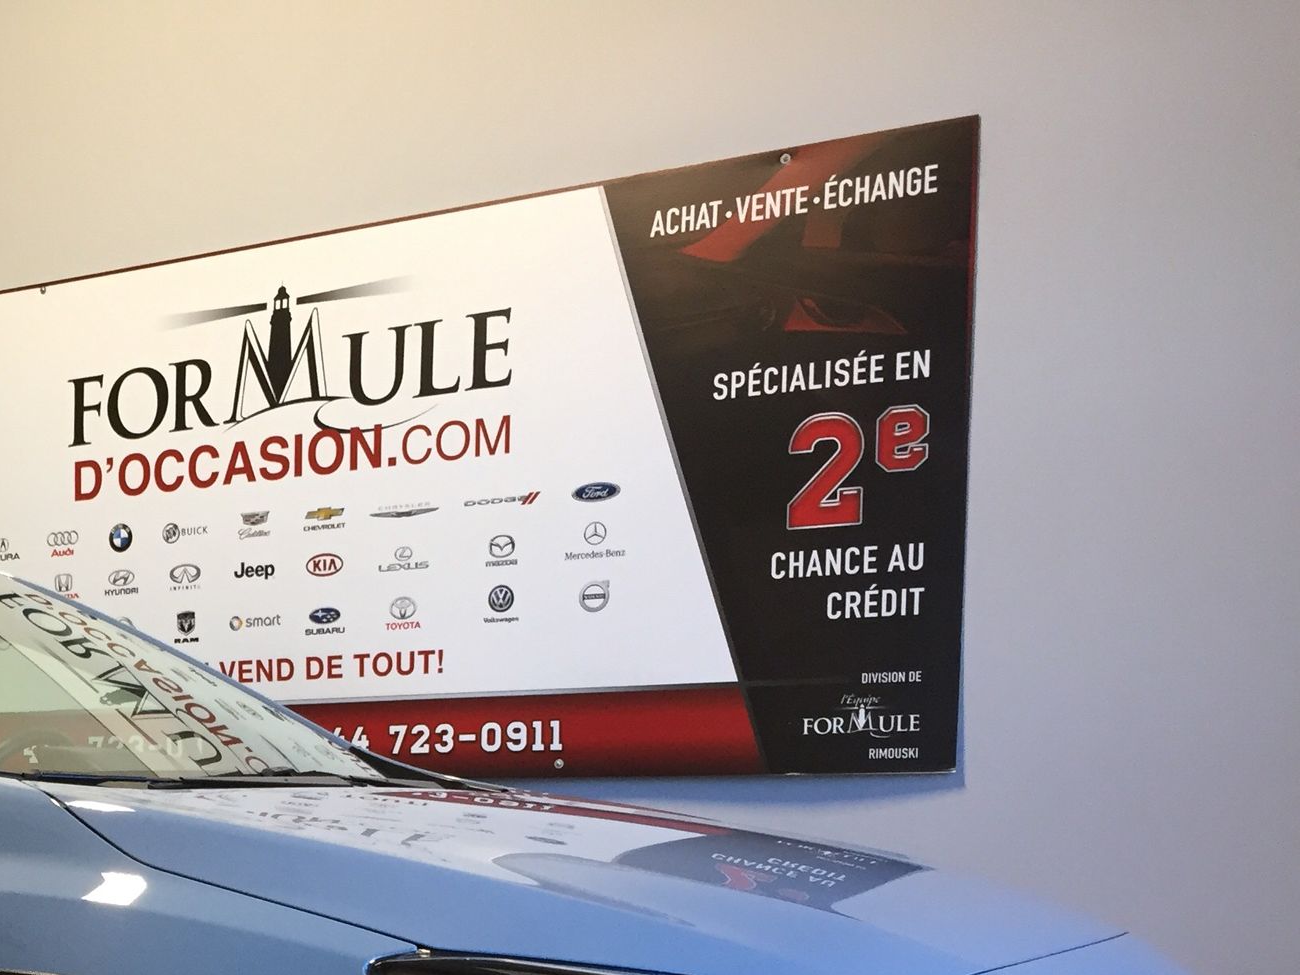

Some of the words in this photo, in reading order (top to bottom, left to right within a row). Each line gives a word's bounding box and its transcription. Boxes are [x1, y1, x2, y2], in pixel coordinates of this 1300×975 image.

[649, 199, 723, 238] ACHAT
[734, 185, 809, 224] VENTE
[823, 163, 939, 209] ÉCHANGE
[66, 306, 513, 448] FORMULE
[712, 350, 885, 401] SPÉCIALISÉE
[895, 349, 931, 381] EN
[73, 414, 513, 501] D'OCCASION.COM
[582, 486, 609, 499] Ford
[463, 495, 528, 507] DODGE
[180, 526, 208, 537] BUICK
[302, 522, 345, 532] CHEVROLET
[50, 547, 75, 558] Audi
[564, 548, 626, 562] Mercedes-Benz
[312, 558, 338, 573] KIA
[378, 560, 430, 573] LEXUS
[770, 545, 879, 580] CHANCE
[887, 542, 925, 573] AU
[233, 561, 275, 580] Jeep
[104, 586, 139, 597] HYUNDAI
[826, 583, 926, 620] CRÉDIT
[245, 613, 282, 628] smart
[385, 620, 422, 631] TOYOTA
[304, 626, 346, 636] SUBARU
[173, 636, 200, 644] RAM
[219, 657, 295, 684] VEND
[305, 655, 343, 681] DE
[353, 649, 445, 678] TOUT!
[860, 671, 906, 684] DIVISION
[908, 670, 922, 682] DE
[802, 711, 921, 738] FORMULE
[388, 720, 564, 755] 723-0911
[868, 747, 919, 760] RIMOUSKI
